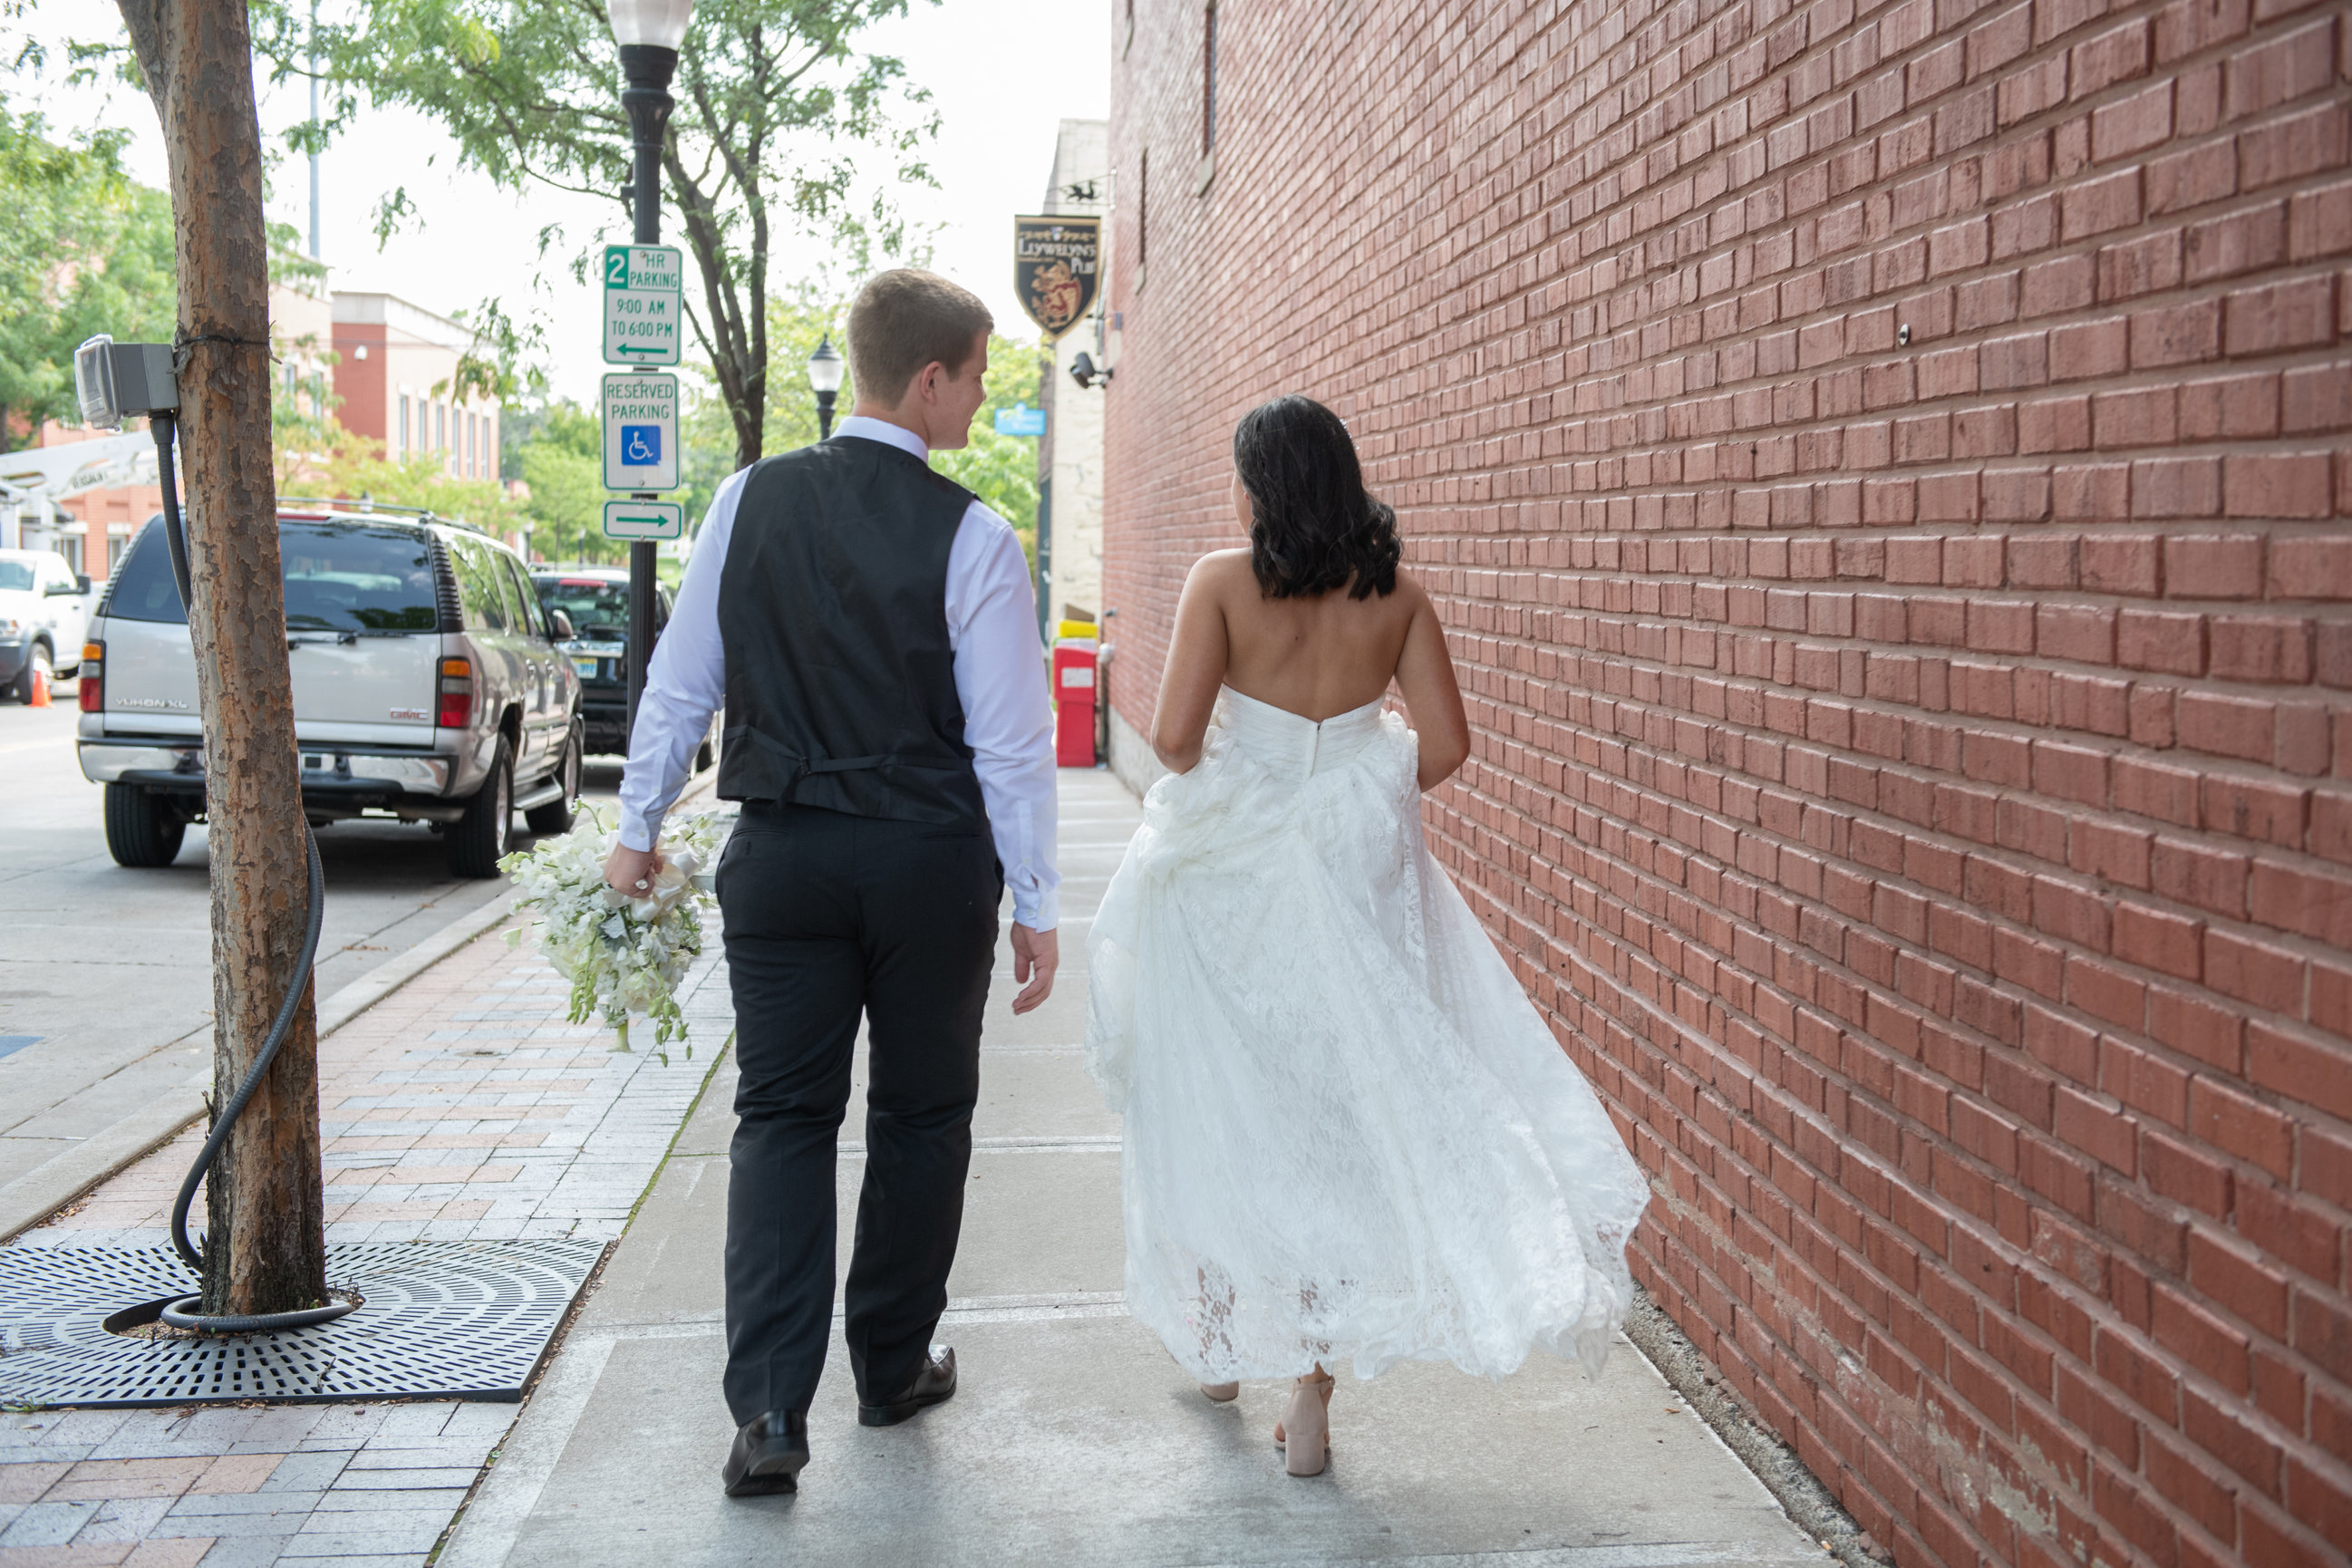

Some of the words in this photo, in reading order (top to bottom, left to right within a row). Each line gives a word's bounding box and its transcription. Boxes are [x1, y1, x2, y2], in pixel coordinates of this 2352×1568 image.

[645, 253, 665, 268] HR
[608, 254, 625, 284] 2
[630, 271, 678, 288] PARKING
[617, 298, 643, 315] 9:00
[648, 300, 665, 315] AM
[612, 321, 625, 335] TO
[629, 322, 653, 336] 6:00
[656, 322, 673, 337] PM
[607, 383, 673, 399] RESERVED
[612, 404, 670, 420] PARKING
[115, 698, 165, 708] YUKON
[168, 699, 189, 709] XL
[390, 707, 429, 720] GMC
